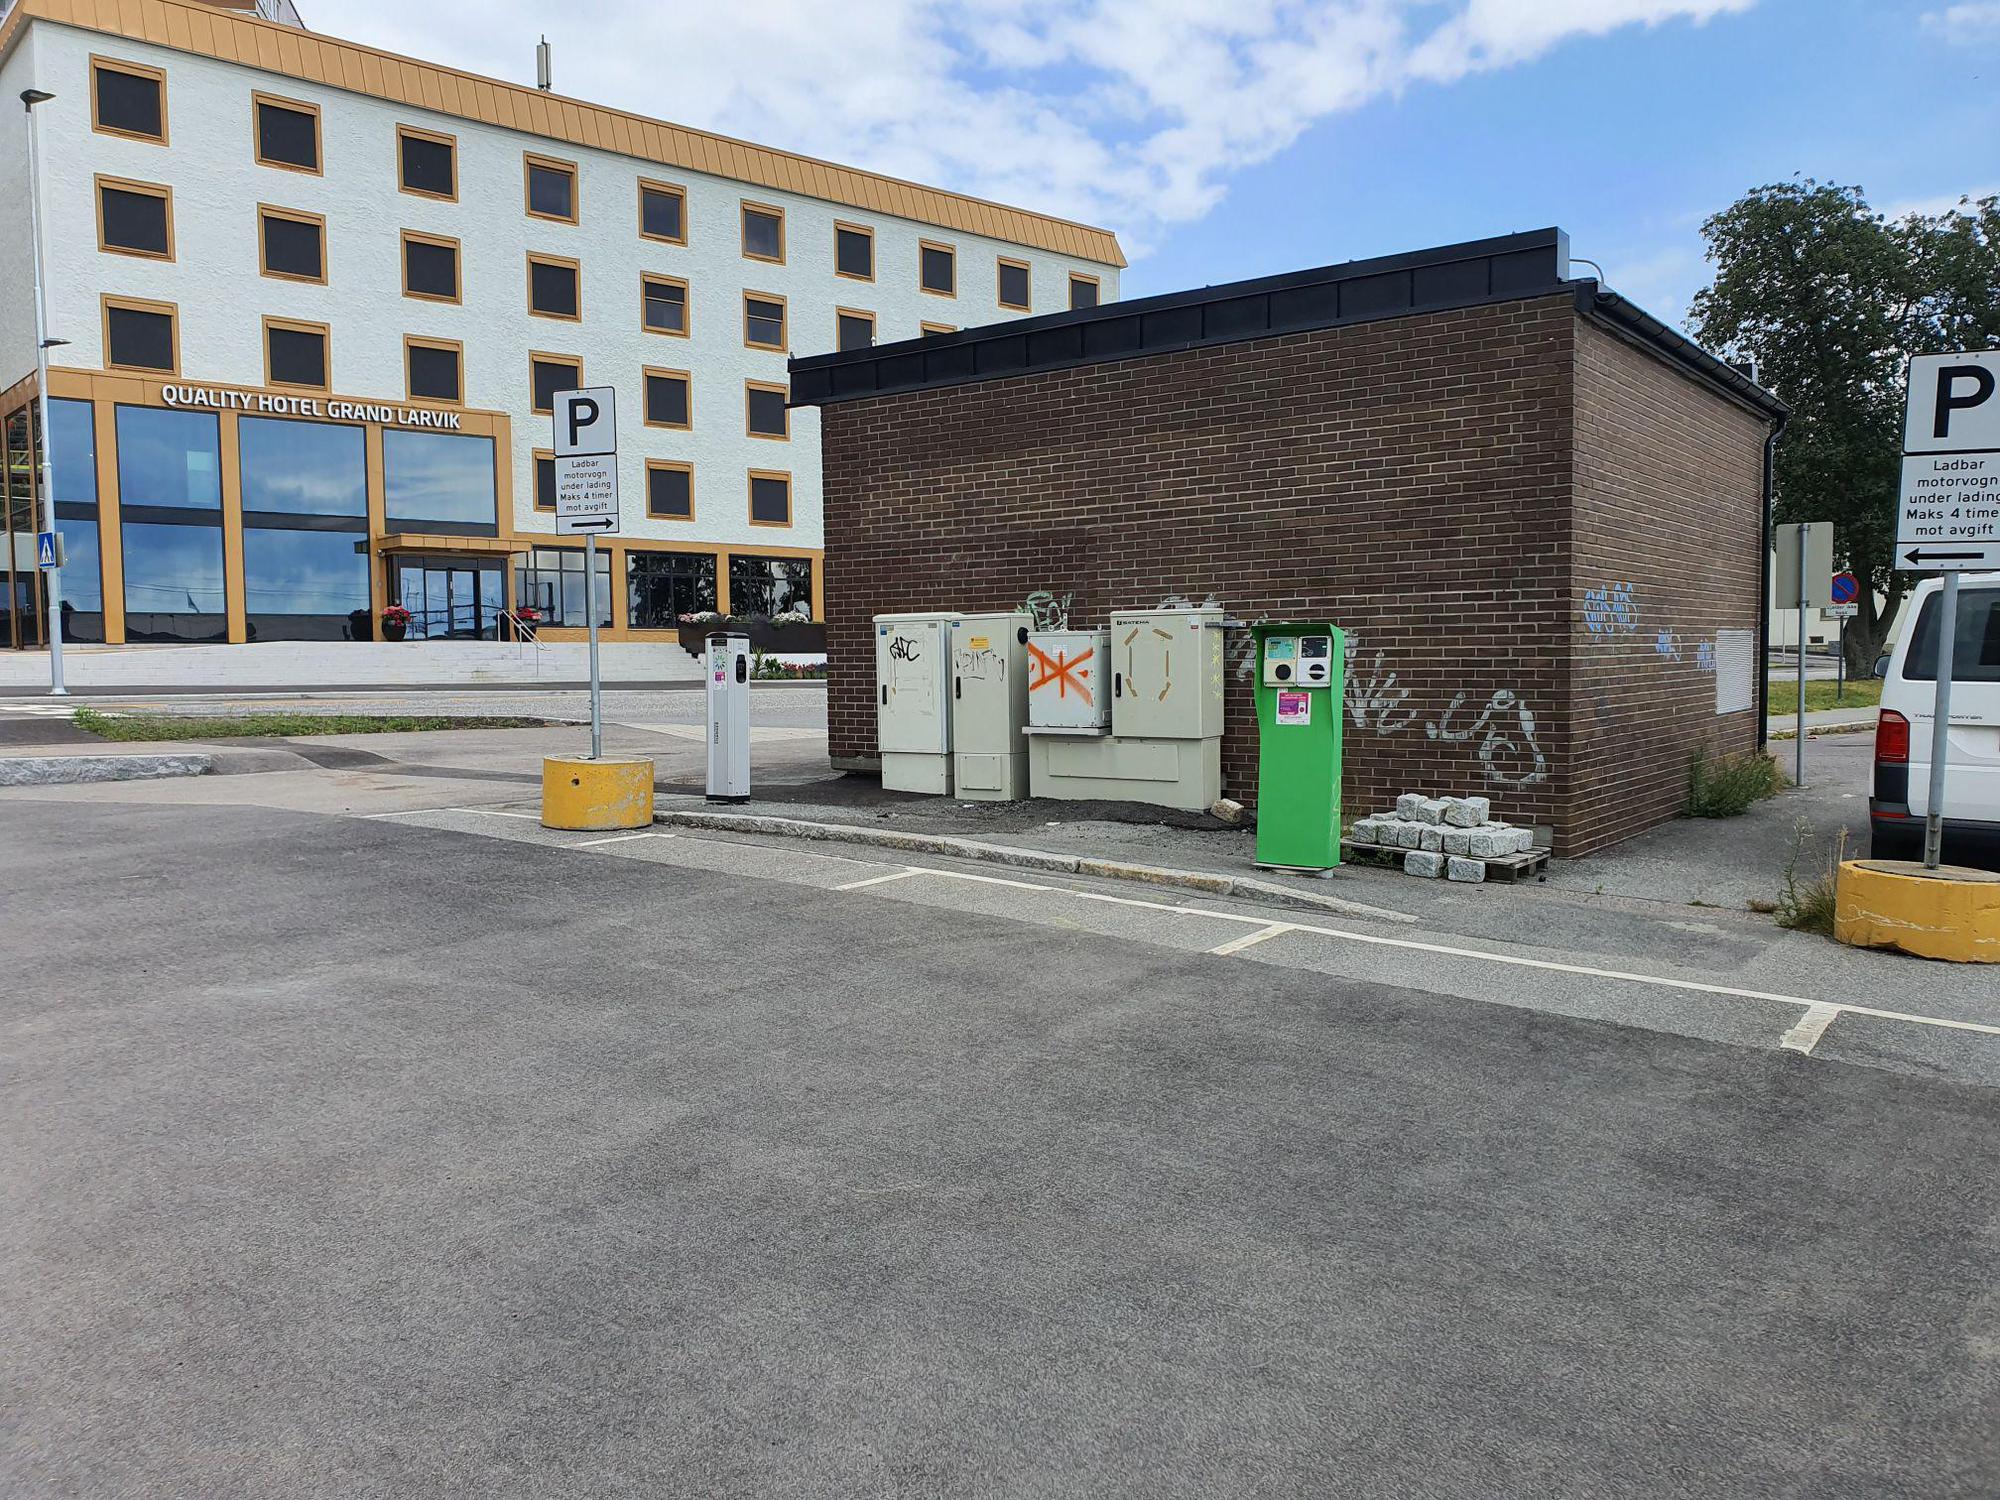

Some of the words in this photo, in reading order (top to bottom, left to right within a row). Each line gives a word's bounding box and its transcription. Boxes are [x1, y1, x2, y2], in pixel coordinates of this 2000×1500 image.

[161, 384, 252, 409] QUALITY
[258, 395, 322, 417] HOTEL
[327, 401, 392, 423] GRAND
[397, 407, 460, 429] LARVIK
[1933, 365, 1995, 438] P
[568, 397, 599, 446] P
[571, 460, 599, 468] Ladbar
[1933, 460, 1985, 471] Ladbar
[564, 471, 607, 480] motorvogn
[561, 482, 584, 490] under
[586, 480, 611, 490] lading
[1917, 476, 1998, 488] motorvogn
[560, 493, 581, 501] Maks
[592, 491, 613, 500] timer
[1909, 493, 1952, 503] under
[584, 502, 608, 512] avgift
[1906, 509, 1943, 520] Maks
[1950, 508, 1960, 518] 4
[1966, 507, 2000, 518] time
[1915, 524, 1943, 536] mot
[1949, 523, 1994, 537] avgift
